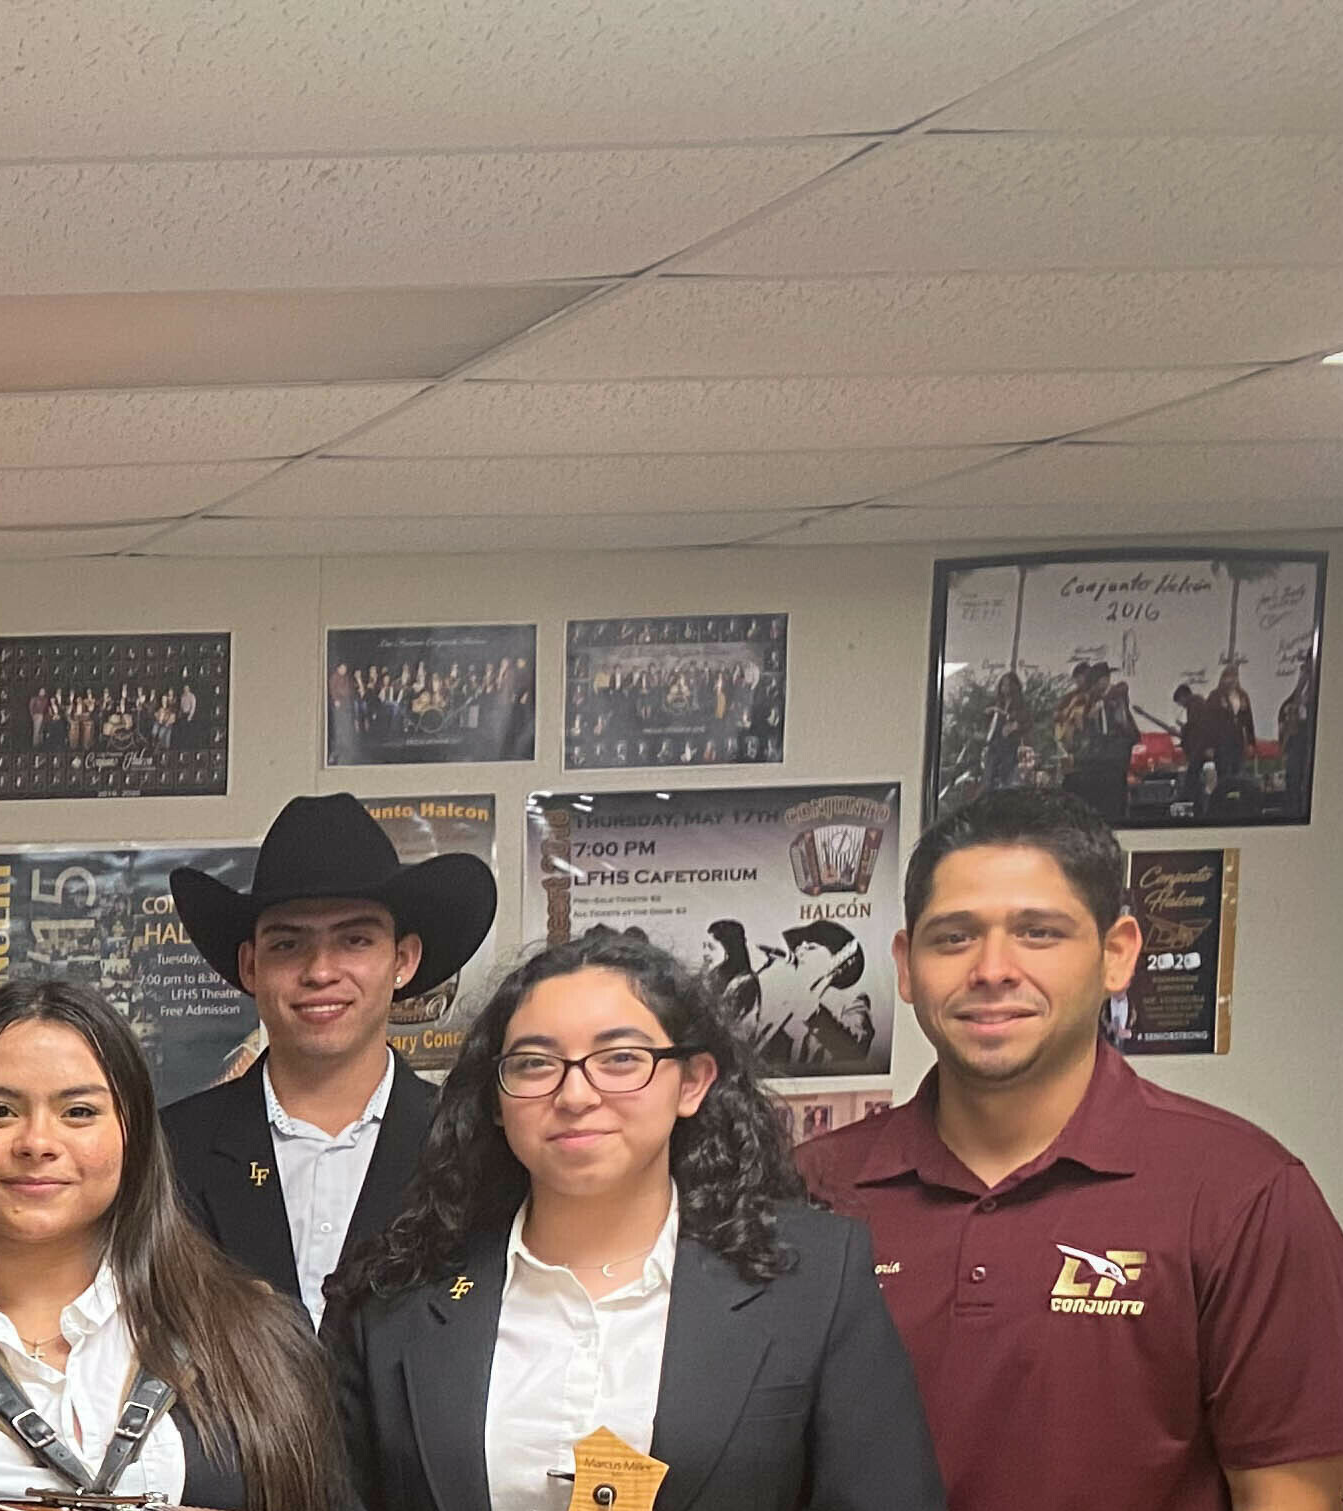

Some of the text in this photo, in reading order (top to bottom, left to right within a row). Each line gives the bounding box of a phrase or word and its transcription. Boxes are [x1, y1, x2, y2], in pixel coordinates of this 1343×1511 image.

[1060, 572, 1153, 601] Conjunto
[1106, 602, 1160, 621] 2016
[420, 802, 489, 821] Halcon
[575, 811, 778, 829] THURSDAY, MAY 17TH
[573, 840, 656, 858] 7:00 PM
[573, 869, 629, 886] LFHS
[800, 897, 872, 920] HALCÓN
[1147, 952, 1202, 971] 2020
[163, 976, 182, 986] pm
[184, 974, 194, 984] to
[198, 973, 221, 984] 8:30
[171, 987, 242, 1000] LFHS Theatre
[160, 1004, 241, 1017] Free Admission
[1051, 1251, 1147, 1297] LF
[449, 1277, 474, 1300] LF
[1051, 1298, 1145, 1316] CONJUNTO
